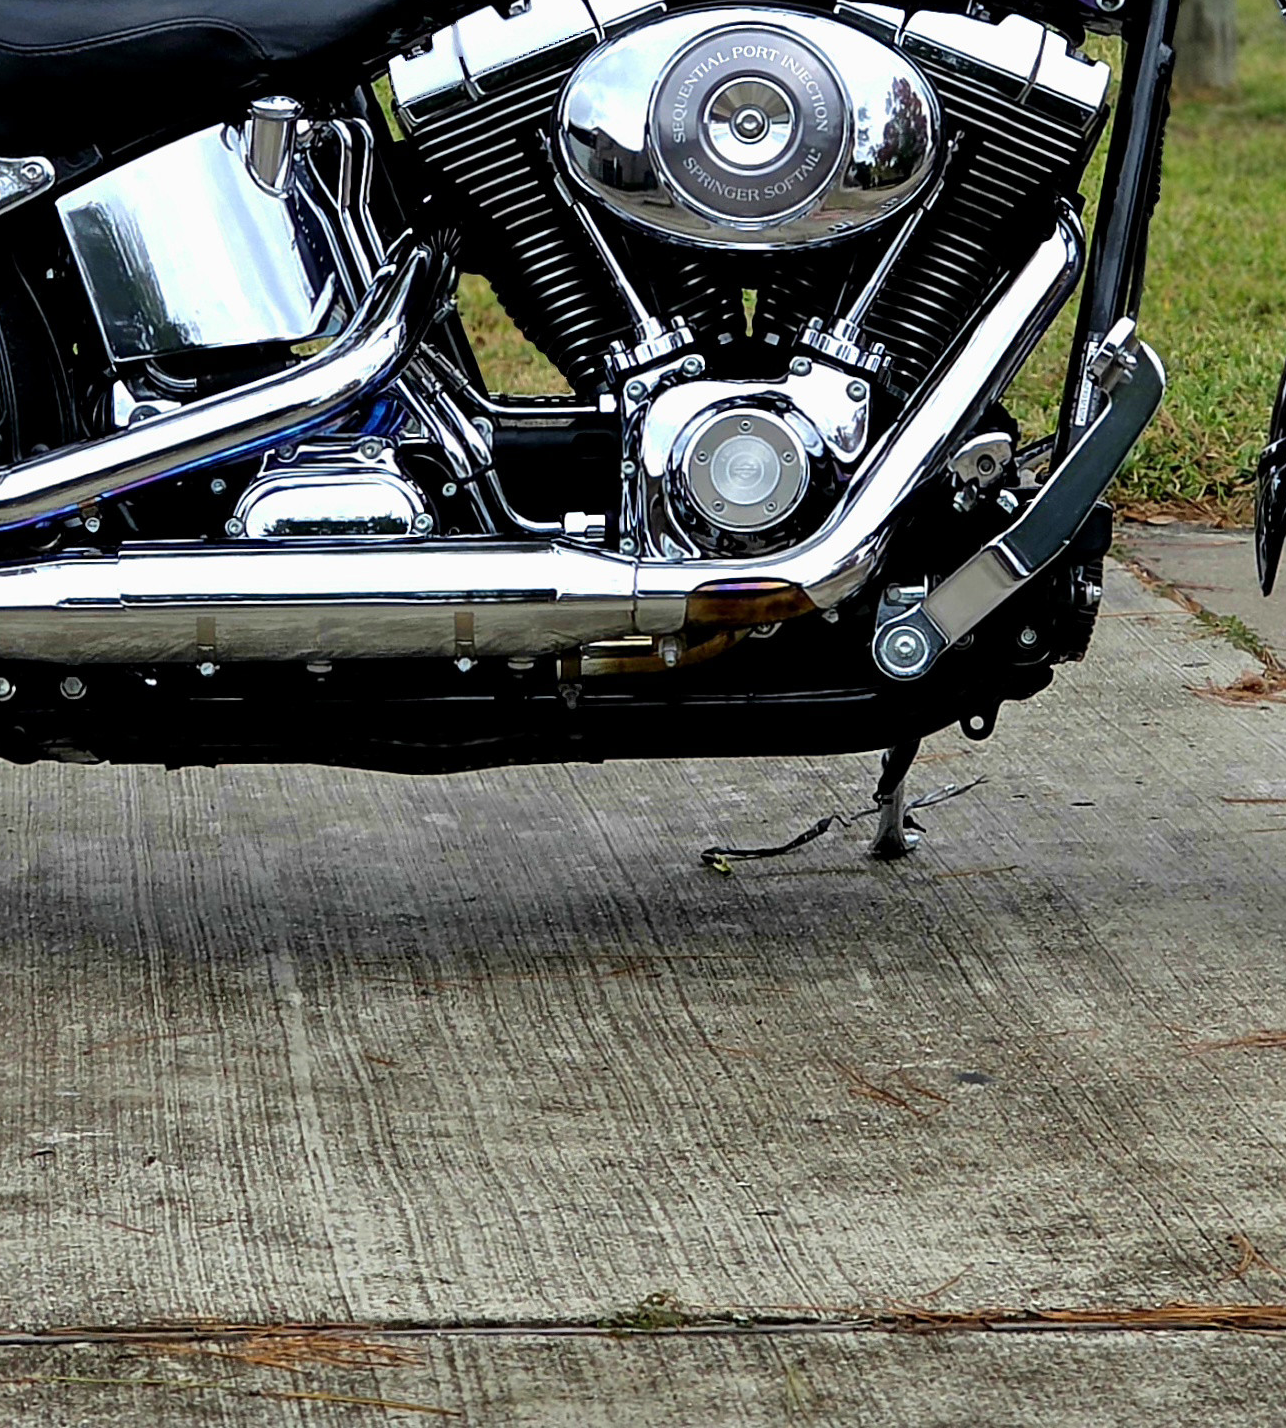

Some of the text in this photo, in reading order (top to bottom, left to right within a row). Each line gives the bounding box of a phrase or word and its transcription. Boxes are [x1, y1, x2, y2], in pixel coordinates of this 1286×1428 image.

[673, 45, 828, 144] SEQUENTIAL PORT INJECTION
[683, 156, 760, 202] SPRINGER
